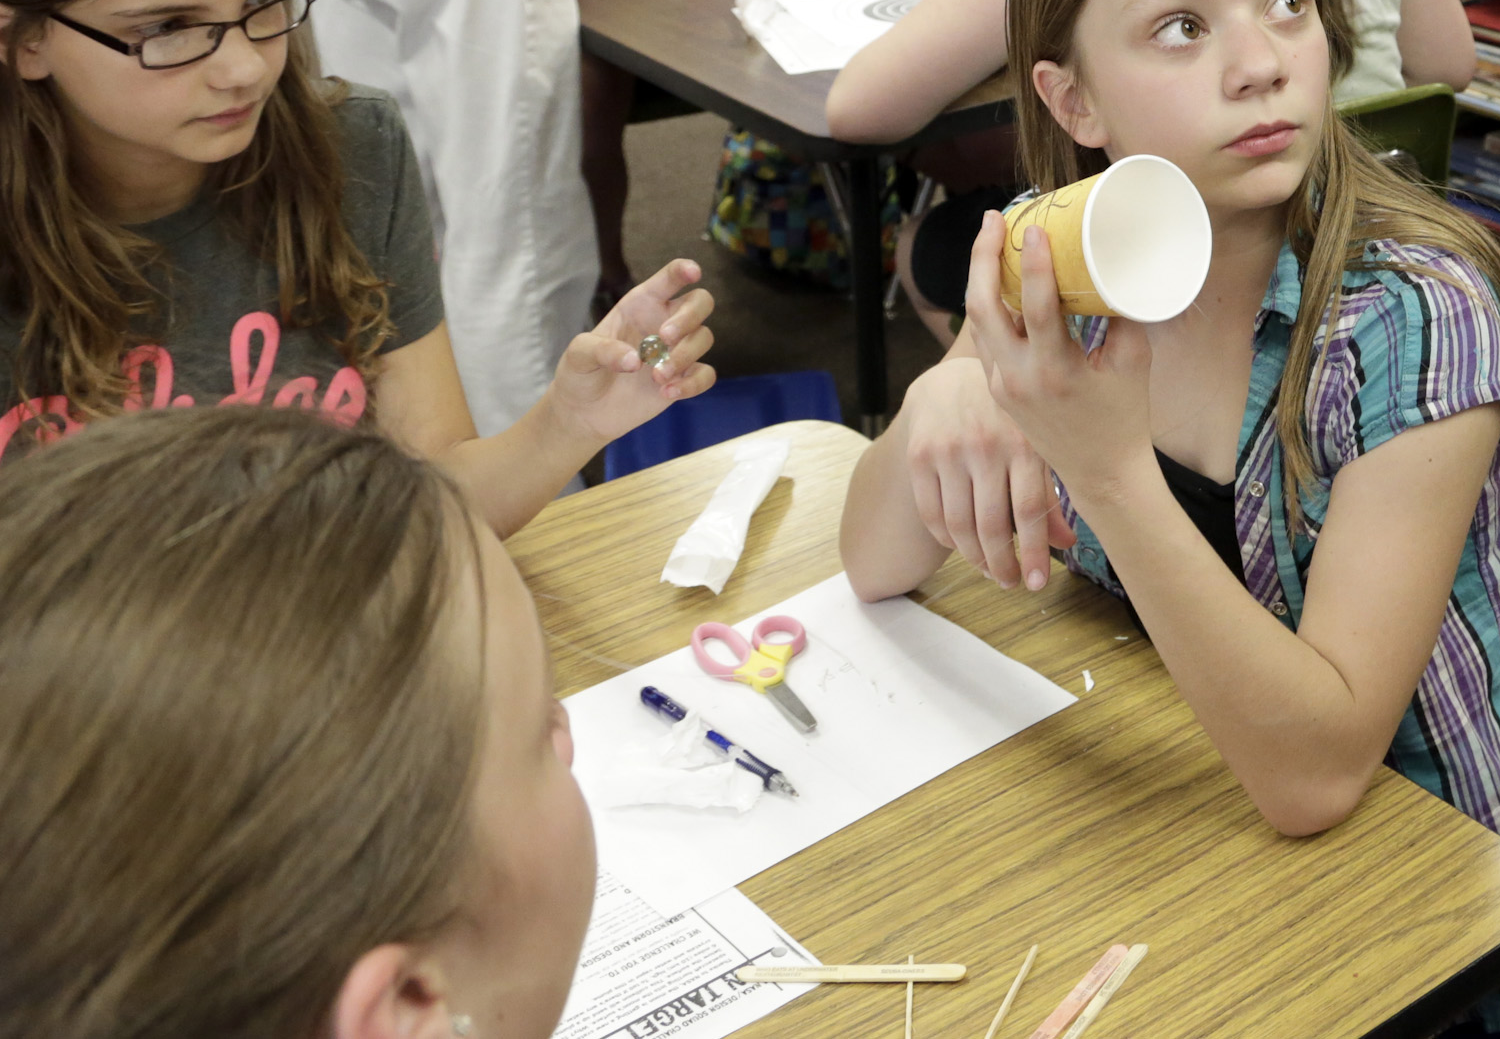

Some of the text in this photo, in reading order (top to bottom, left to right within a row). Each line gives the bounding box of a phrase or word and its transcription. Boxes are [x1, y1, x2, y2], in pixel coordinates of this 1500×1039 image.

[630, 913, 686, 943] BRAINSTORM
[685, 927, 701, 938] WE
[611, 940, 633, 953] AND
[637, 934, 687, 962] CHALLENGE
[579, 949, 613, 969] DESIGN
[618, 959, 639, 971] YOU
[624, 984, 722, 1039] TARGET
[679, 1010, 709, 1027] SQUAD
